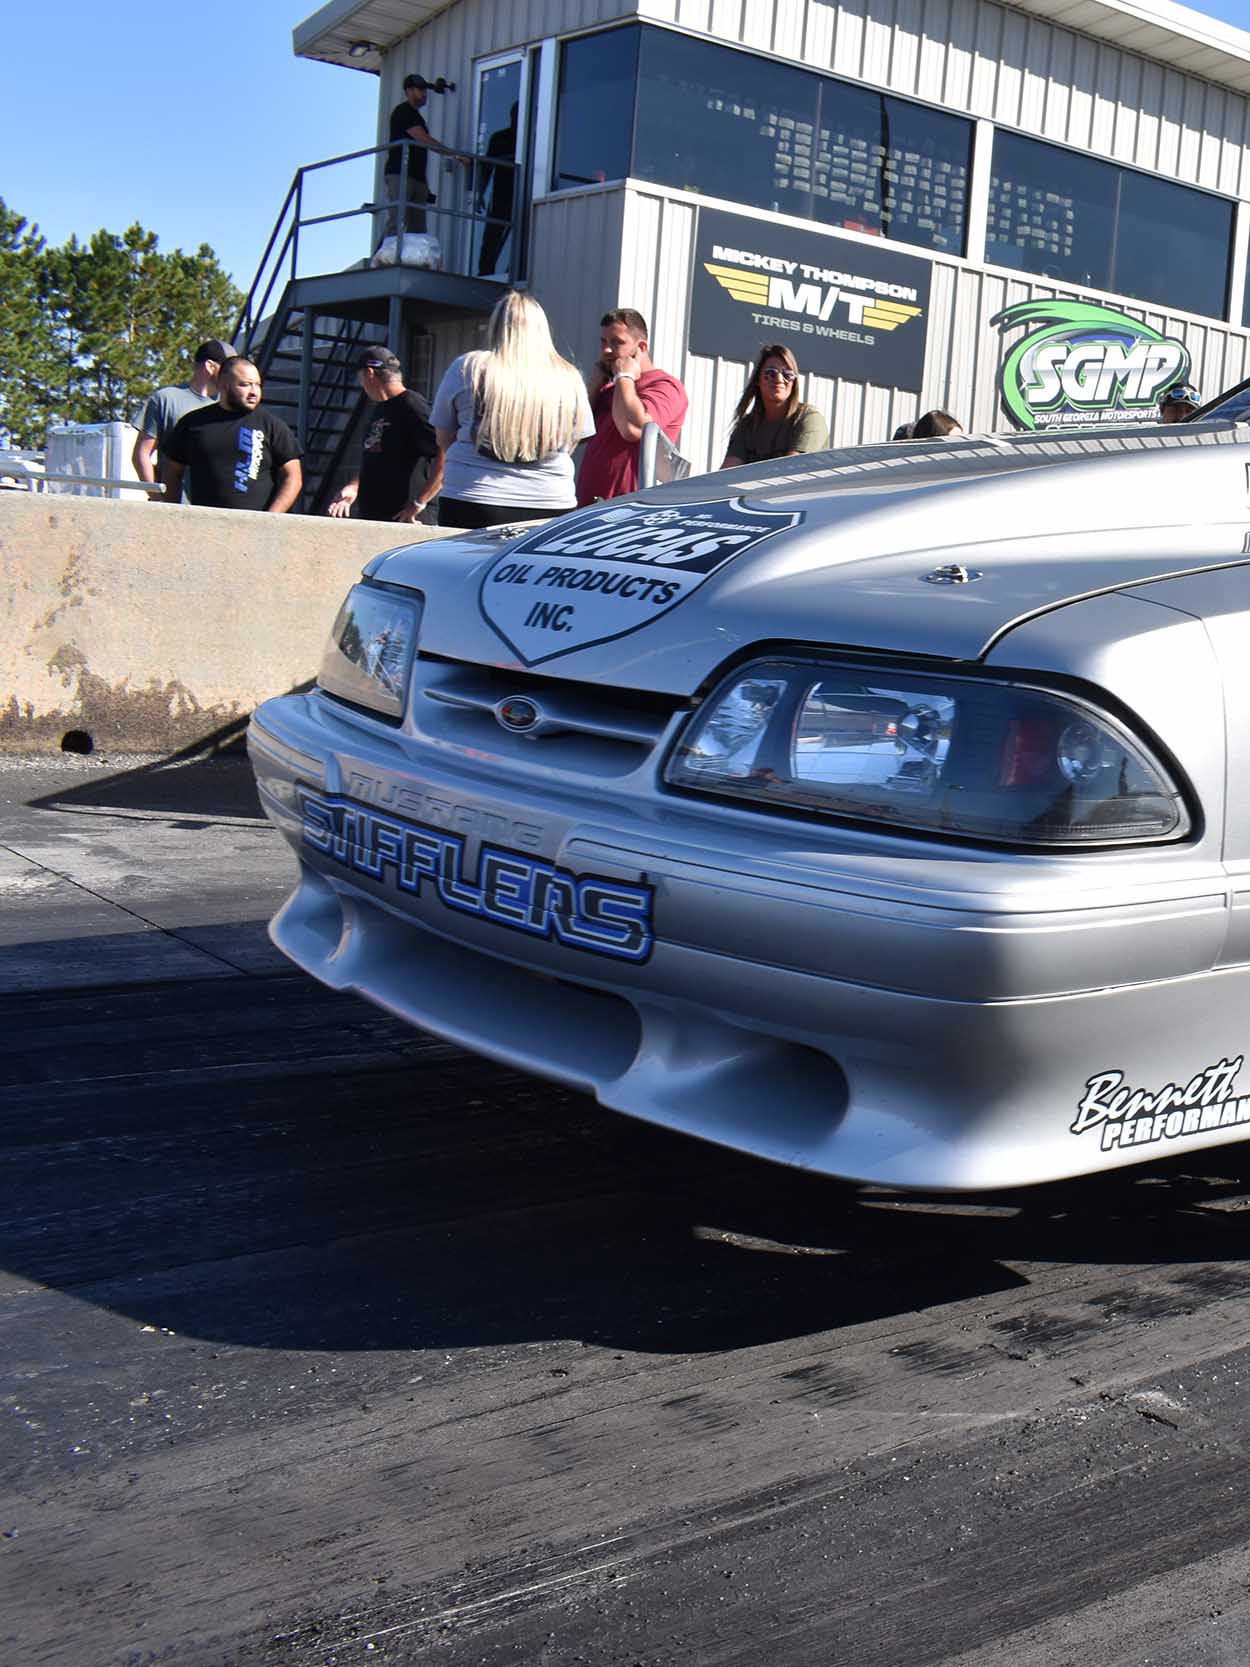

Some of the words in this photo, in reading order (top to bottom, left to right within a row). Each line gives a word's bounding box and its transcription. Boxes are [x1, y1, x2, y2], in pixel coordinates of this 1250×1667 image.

[712, 245, 798, 275] MICKEY
[799, 264, 917, 301] THOMPSON
[768, 277, 875, 325] M/T
[752, 313, 801, 332] TIRES
[803, 324, 815, 334] &
[816, 326, 876, 345] WHEELS
[1027, 344, 1182, 403] SGMP
[1034, 413, 1061, 424] SOUTH
[1063, 412, 1099, 423] GEORGIA
[1100, 409, 1157, 421] MOTORSPORTS
[533, 523, 752, 565] LUCAS
[494, 564, 527, 585] OIL
[534, 566, 681, 604] PRODUCTS
[524, 601, 574, 633] INC.
[298, 783, 656, 965] STIFFLERS
[1070, 1055, 1244, 1134] Bennett
